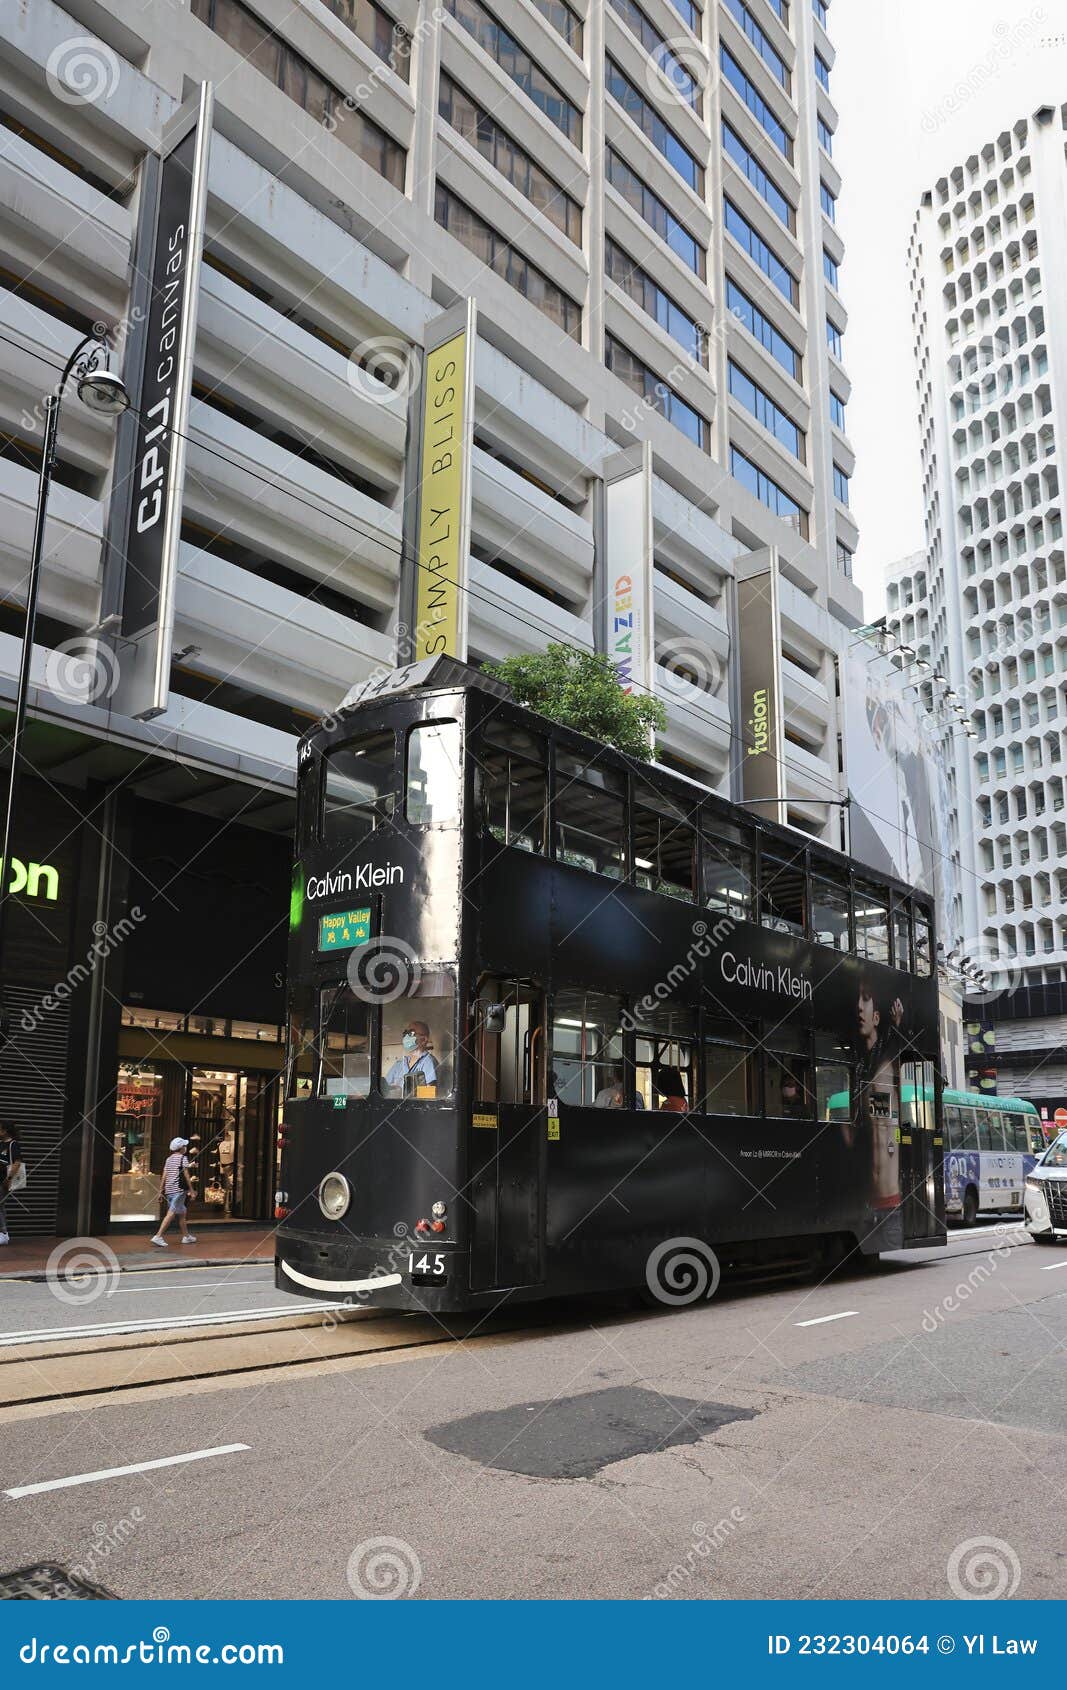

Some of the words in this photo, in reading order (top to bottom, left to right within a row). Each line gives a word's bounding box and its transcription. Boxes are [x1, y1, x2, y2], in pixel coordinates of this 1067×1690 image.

[432, 361, 456, 475] BLISS
[425, 508, 451, 656] SIMPLY
[615, 575, 632, 697] MAZED
[356, 663, 419, 702] 145
[748, 689, 768, 755] fusion
[0, 855, 59, 901] on
[306, 870, 352, 900] Calvin
[355, 861, 404, 889] Klein
[323, 915, 346, 929] Happy
[348, 910, 371, 925] Valley
[720, 951, 775, 992] Calvin
[778, 966, 813, 1001] Klein
[409, 1252, 446, 1275] 145
